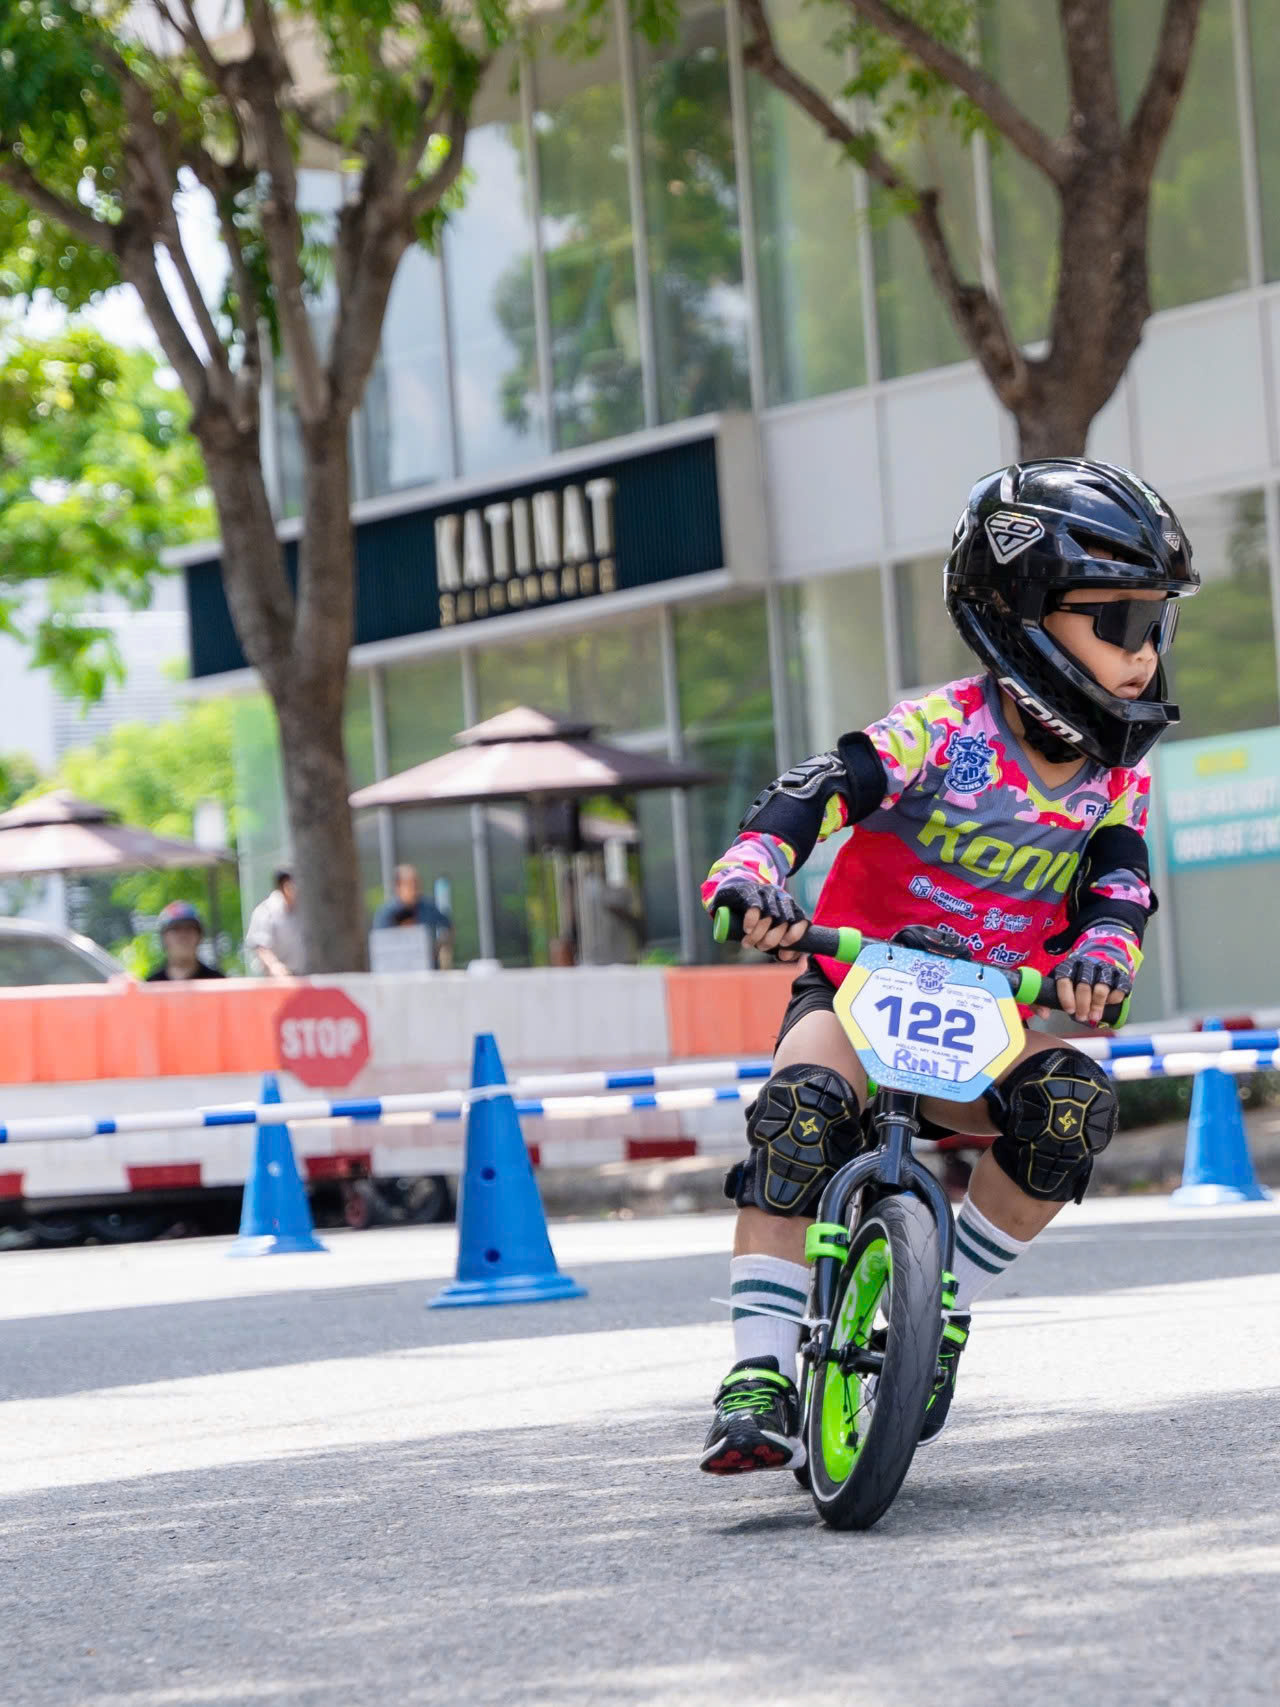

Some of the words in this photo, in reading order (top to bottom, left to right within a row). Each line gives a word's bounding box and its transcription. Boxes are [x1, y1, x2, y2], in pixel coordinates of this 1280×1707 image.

[932, 894, 975, 918] Resources
[935, 887, 973, 912] Learning
[281, 1018, 359, 1058] STOP
[874, 995, 975, 1053] 122
